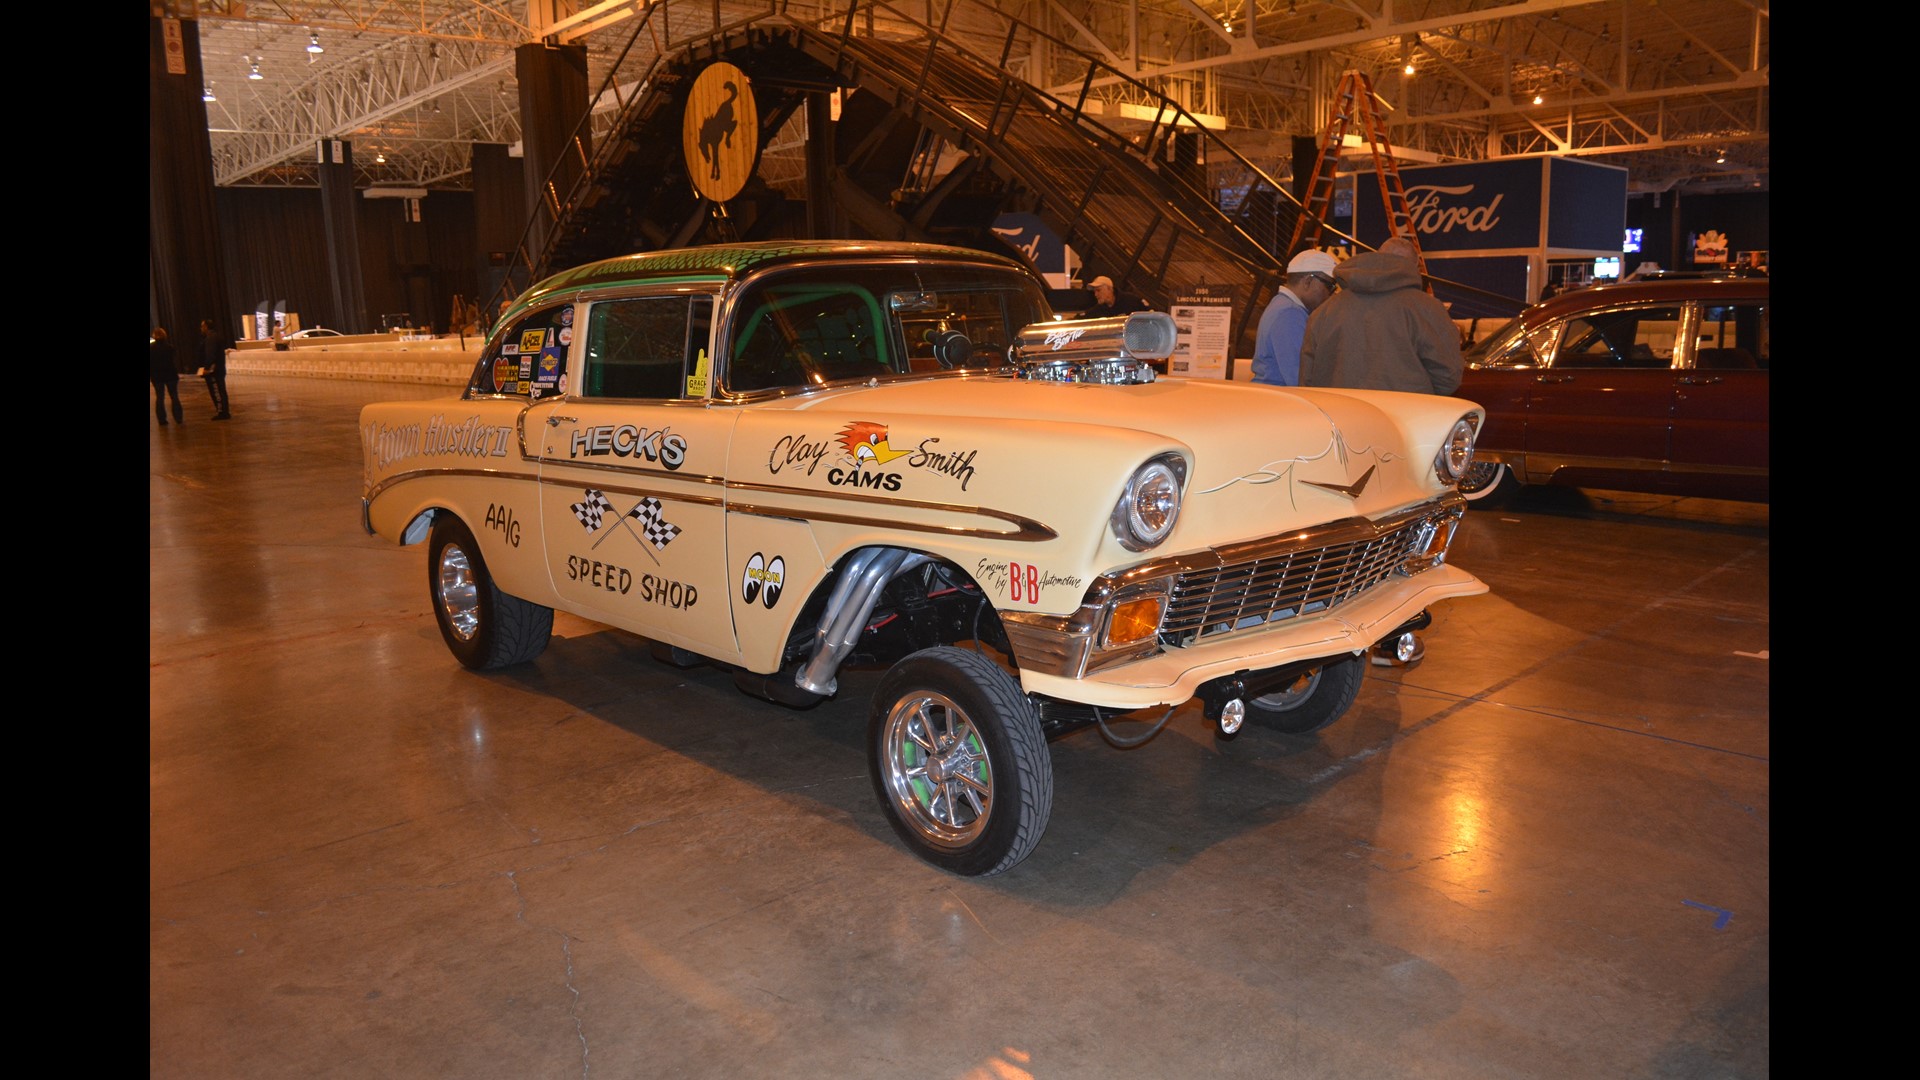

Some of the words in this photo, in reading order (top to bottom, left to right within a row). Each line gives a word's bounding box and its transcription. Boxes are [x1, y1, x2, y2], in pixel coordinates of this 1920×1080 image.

[1397, 184, 1504, 233] Ford
[423, 413, 495, 458] Hustler
[490, 427, 513, 457] II
[570, 424, 687, 470] HECK'S
[768, 434, 829, 476] Clay
[908, 437, 977, 491] Smith
[827, 468, 903, 491] CAMS
[485, 503, 520, 548] AA/G
[566, 554, 632, 595] SPEED
[640, 573, 698, 611] SHOP
[748, 567, 780, 583] MOON
[976, 558, 1008, 580] Engine
[1038, 570, 1082, 591] Automotive
[995, 576, 1008, 597] by
